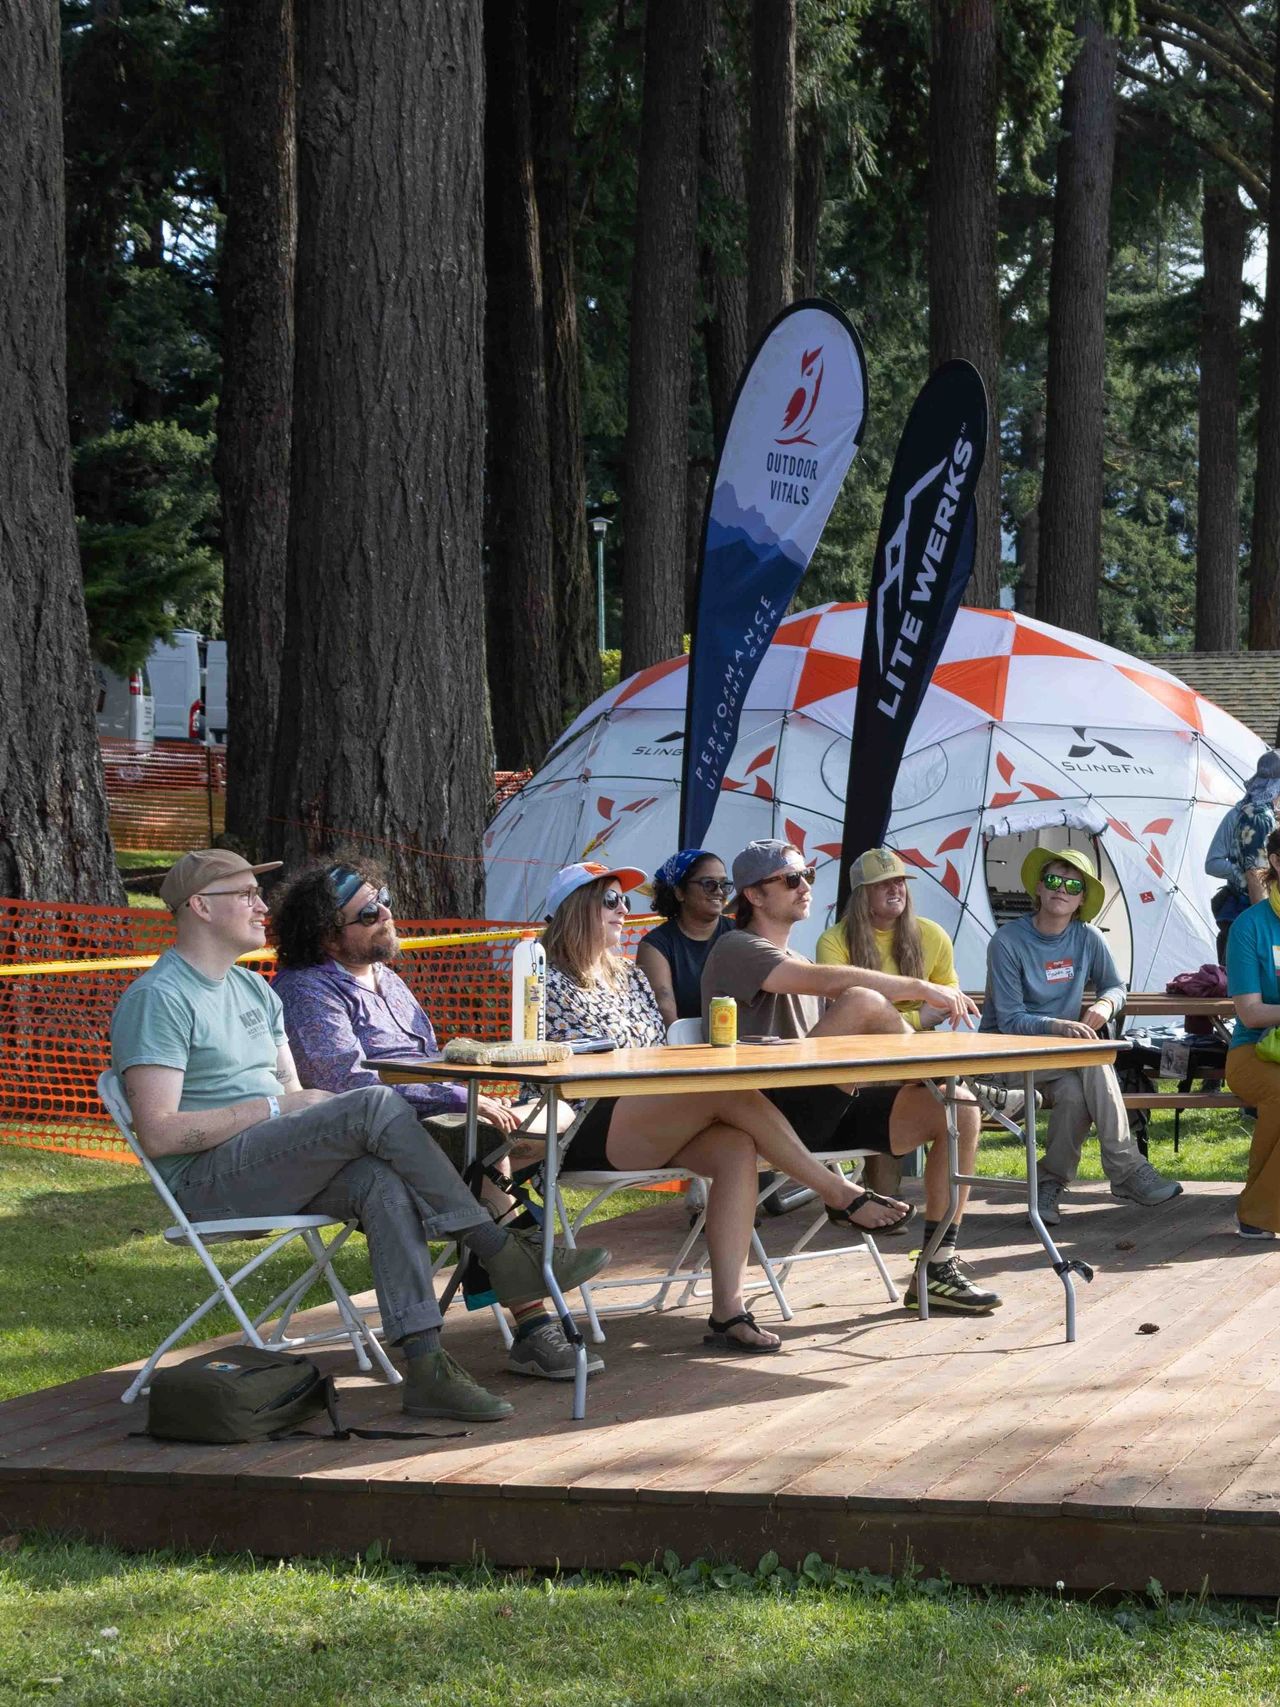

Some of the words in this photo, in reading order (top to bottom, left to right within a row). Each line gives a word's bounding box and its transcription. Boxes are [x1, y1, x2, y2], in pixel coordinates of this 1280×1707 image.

[766, 451, 818, 480] OUTDOOR
[770, 479, 810, 506] VITALS
[877, 610, 923, 720] LITE
[910, 437, 973, 603] WERKS
[749, 609, 777, 658] GEAR
[695, 595, 771, 781] PERFORMANCE
